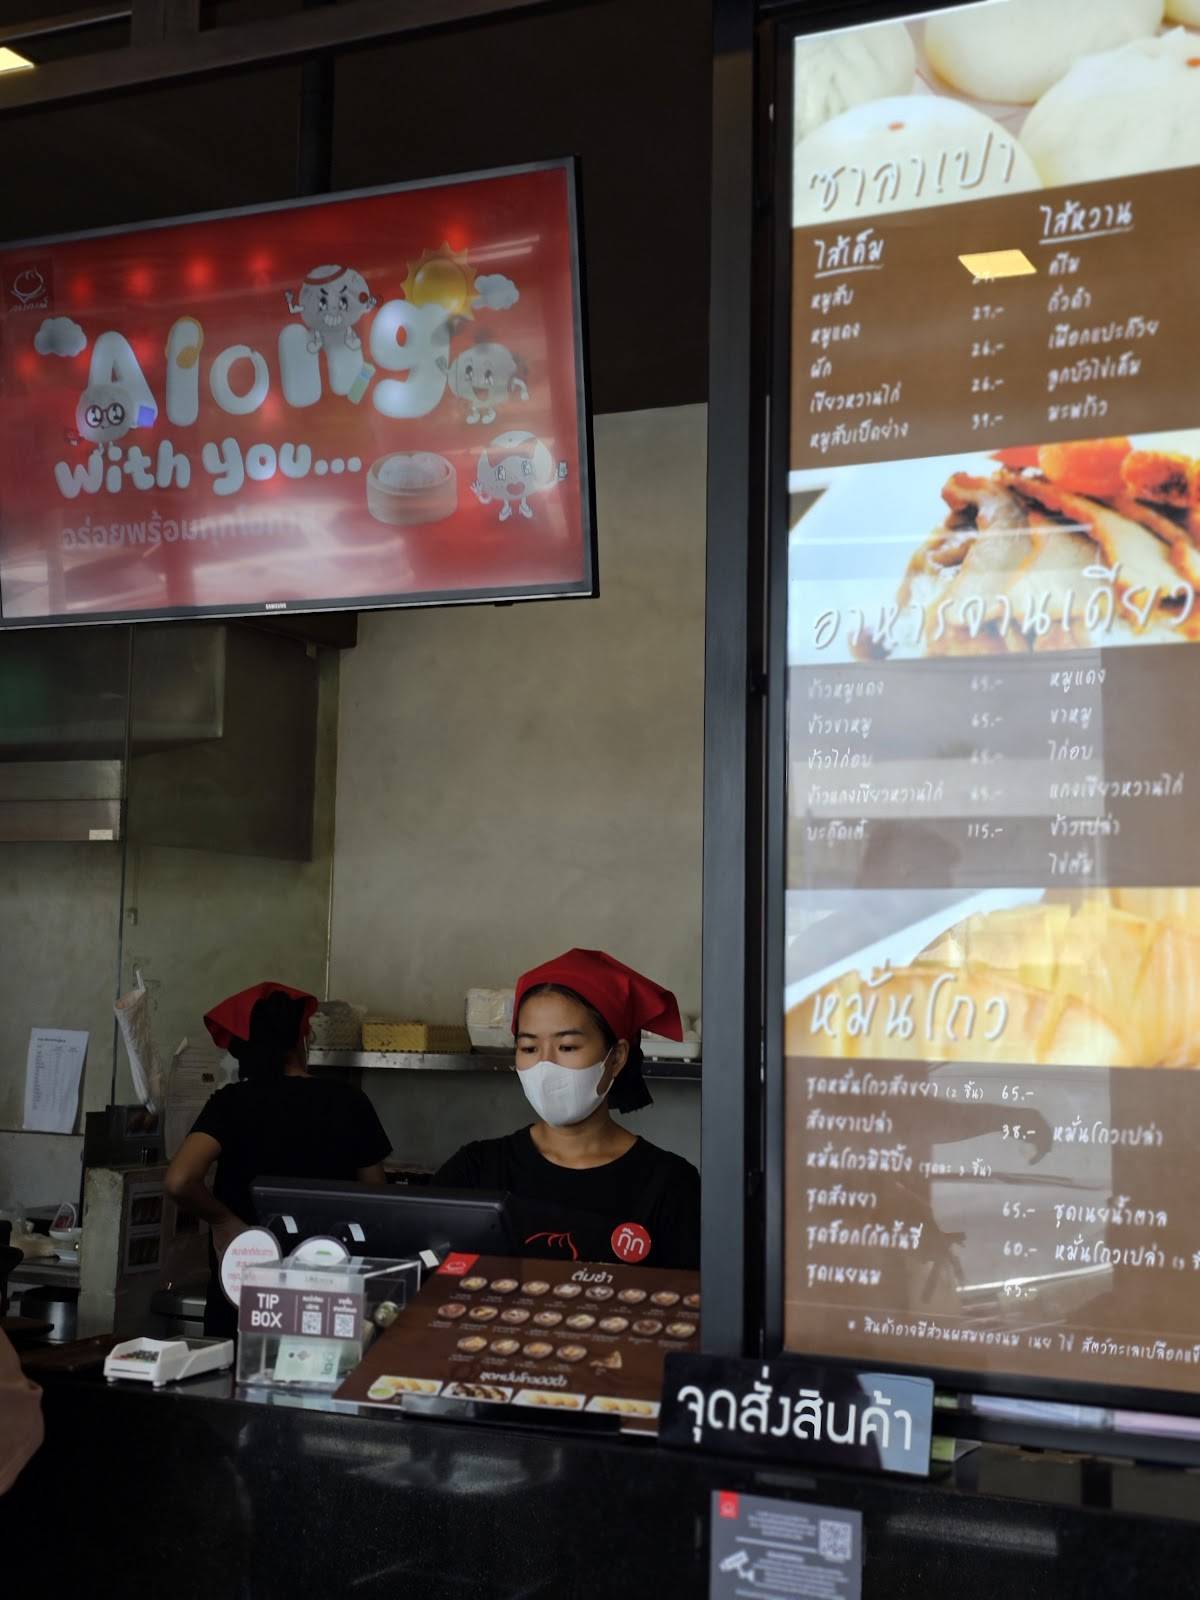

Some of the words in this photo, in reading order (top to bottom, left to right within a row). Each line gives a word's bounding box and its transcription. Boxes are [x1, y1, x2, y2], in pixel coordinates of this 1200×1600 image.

[808, 131, 1017, 212] ซาลาเปา
[1040, 200, 1134, 236] ไส้หวาน
[813, 229, 884, 269] ไส้เค็ม
[810, 321, 861, 353] หมูแดง
[84, 299, 451, 428] Along
[810, 356, 833, 379] ผัก
[809, 381, 903, 414] เขียวหวานไก่
[1047, 395, 1109, 422] มะพร้าว
[809, 417, 910, 454] หมูสับเป็ดย่าง
[54, 440, 192, 500] with
[812, 563, 1195, 651] อาหารจานเดียว
[807, 676, 885, 704] ข้าวหมูแดง
[1049, 666, 1106, 694] หมูแดง
[807, 711, 873, 739] ข้าวขาหมู
[1049, 705, 1092, 732] ขาหมู
[807, 746, 873, 770] ข้าวไก่อบ
[1048, 738, 1094, 762] ไก่อบ
[806, 780, 944, 806] ข้าวแกงเขียวหวานไก่
[1049, 772, 1184, 799] แกงเขียวหวานไก่
[966, 822, 1004, 840] 115.-
[1049, 814, 1121, 839] ข้าวเปล่า
[1048, 848, 1094, 876] ไข่ต้ม
[1001, 1084, 1035, 1102] 65.-
[805, 1108, 893, 1134] สังขยาเปล่า
[1001, 1124, 1036, 1140] 38.-
[805, 1184, 878, 1213] ชุดสังขยา
[1002, 1200, 1036, 1219] 65.-
[1053, 1195, 1169, 1229] ชุดเนยน้ำตาล
[1003, 1240, 1038, 1258] 60.-
[805, 1262, 882, 1288] ชุดเนยนม
[256, 1293, 280, 1310] TIP
[250, 1311, 283, 1329] BOX
[1057, 1333, 1076, 1353] ไข่
[676, 1365, 913, 1451] จุดสั่งสินค้า
